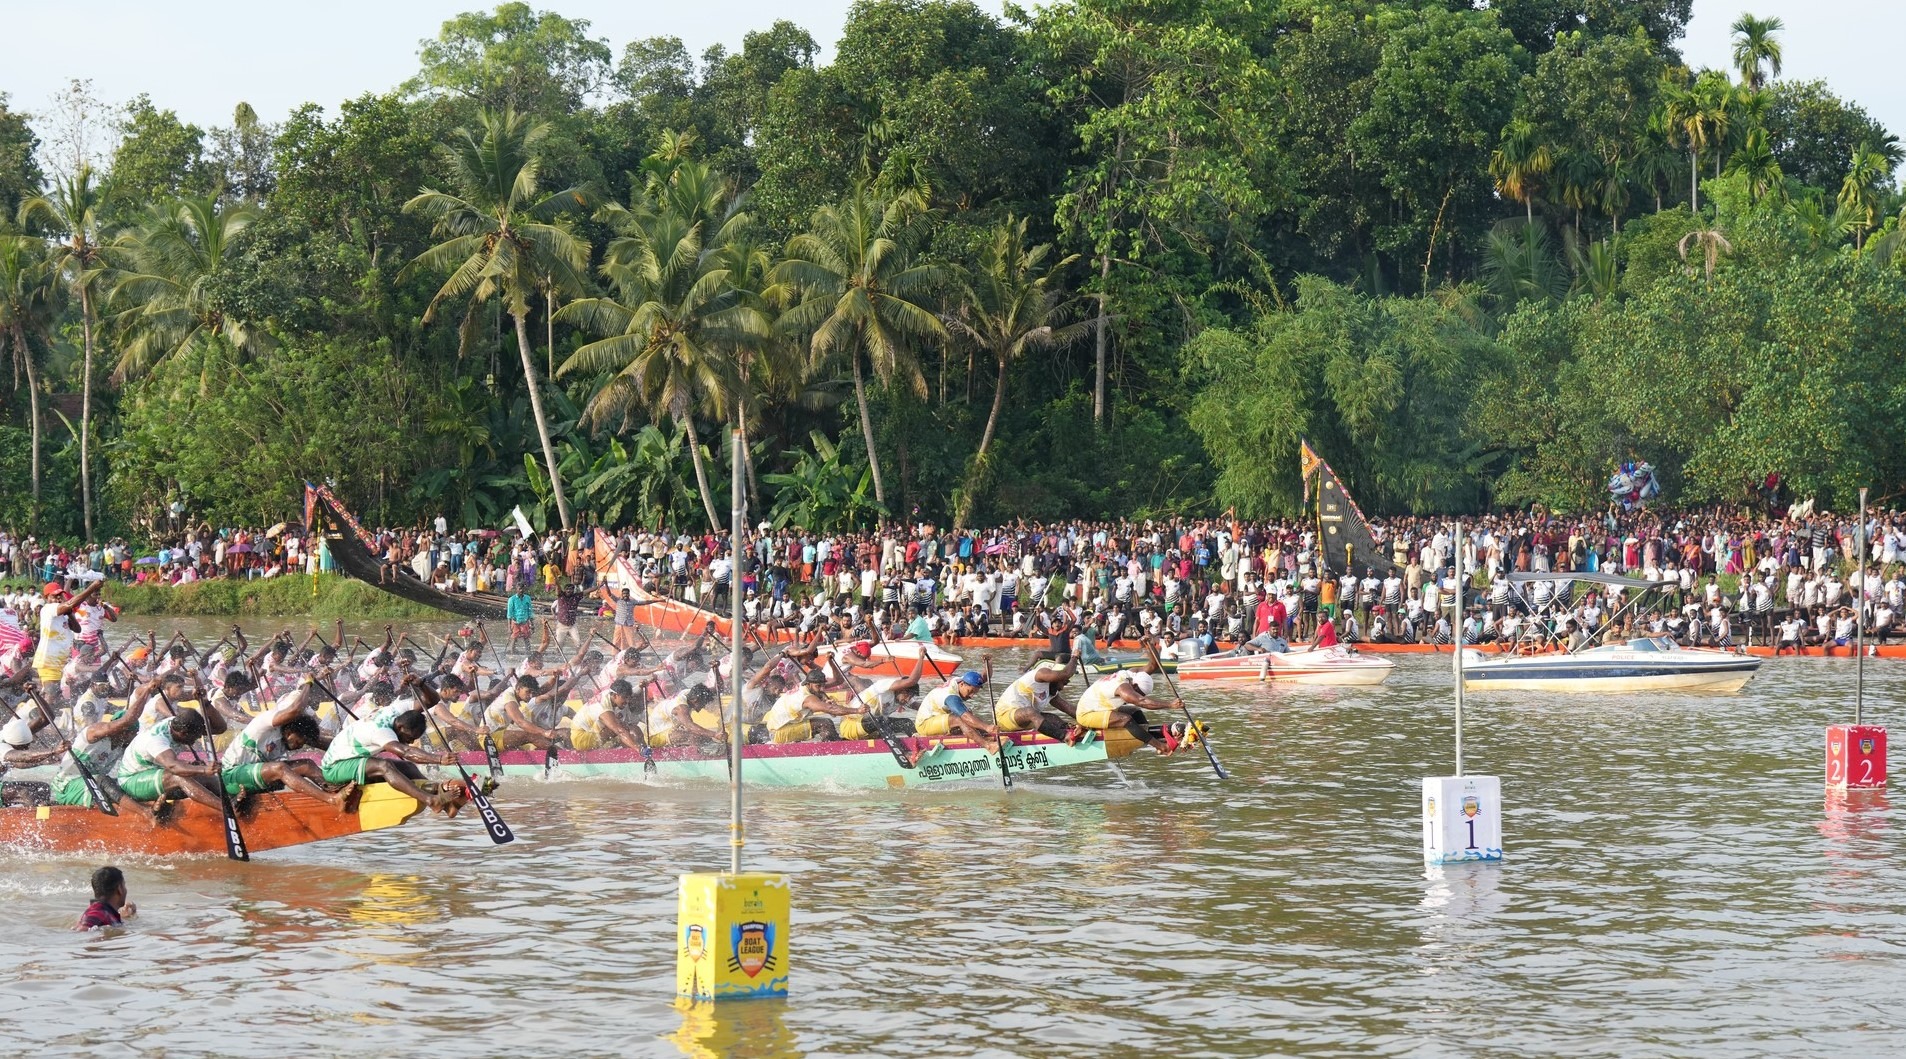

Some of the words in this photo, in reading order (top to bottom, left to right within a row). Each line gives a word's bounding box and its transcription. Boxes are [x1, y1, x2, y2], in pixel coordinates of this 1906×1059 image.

[918, 754, 991, 781] പള്ളാത്തുരുത്തി
[1831, 759, 1841, 781] 2
[1860, 759, 1873, 783] 2
[88, 778, 111, 811] UBC
[475, 795, 506, 837] UBC
[227, 817, 244, 858] UBC
[1429, 820, 1436, 850] 1
[1465, 819, 1479, 850] 1
[740, 945, 765, 954] LEAGUE
[744, 937, 761, 945] BOAT
